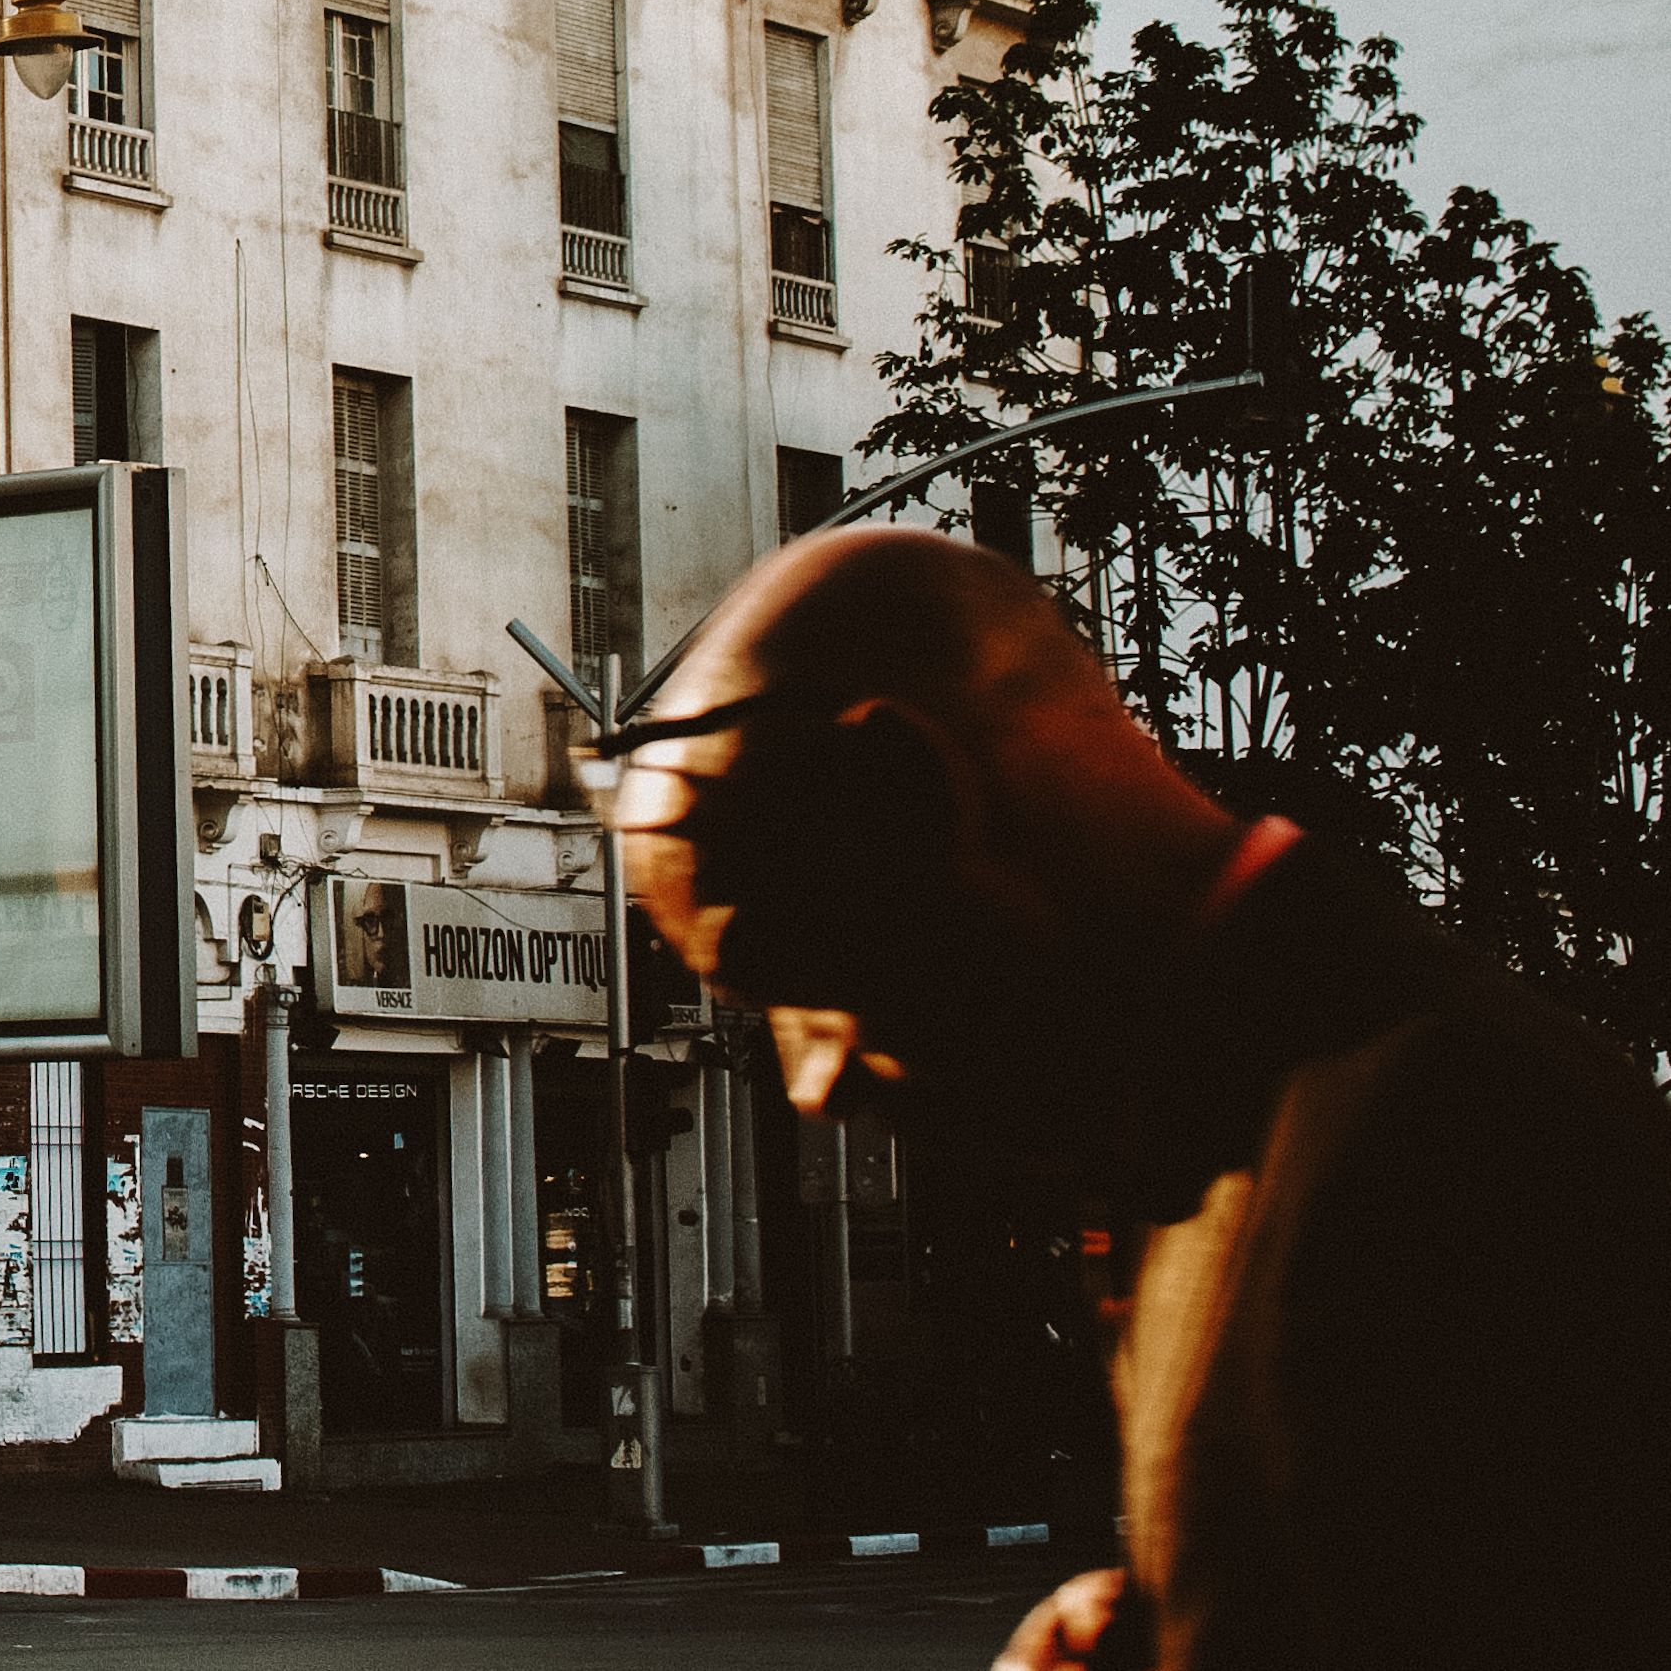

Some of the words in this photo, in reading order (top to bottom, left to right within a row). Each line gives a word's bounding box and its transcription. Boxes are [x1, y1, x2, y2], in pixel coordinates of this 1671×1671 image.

[423, 923, 525, 983] HORIZON
[528, 928, 607, 992] OPTIQU
[376, 990, 413, 1009] VERSACE
[356, 1083, 418, 1099] DESIGN
